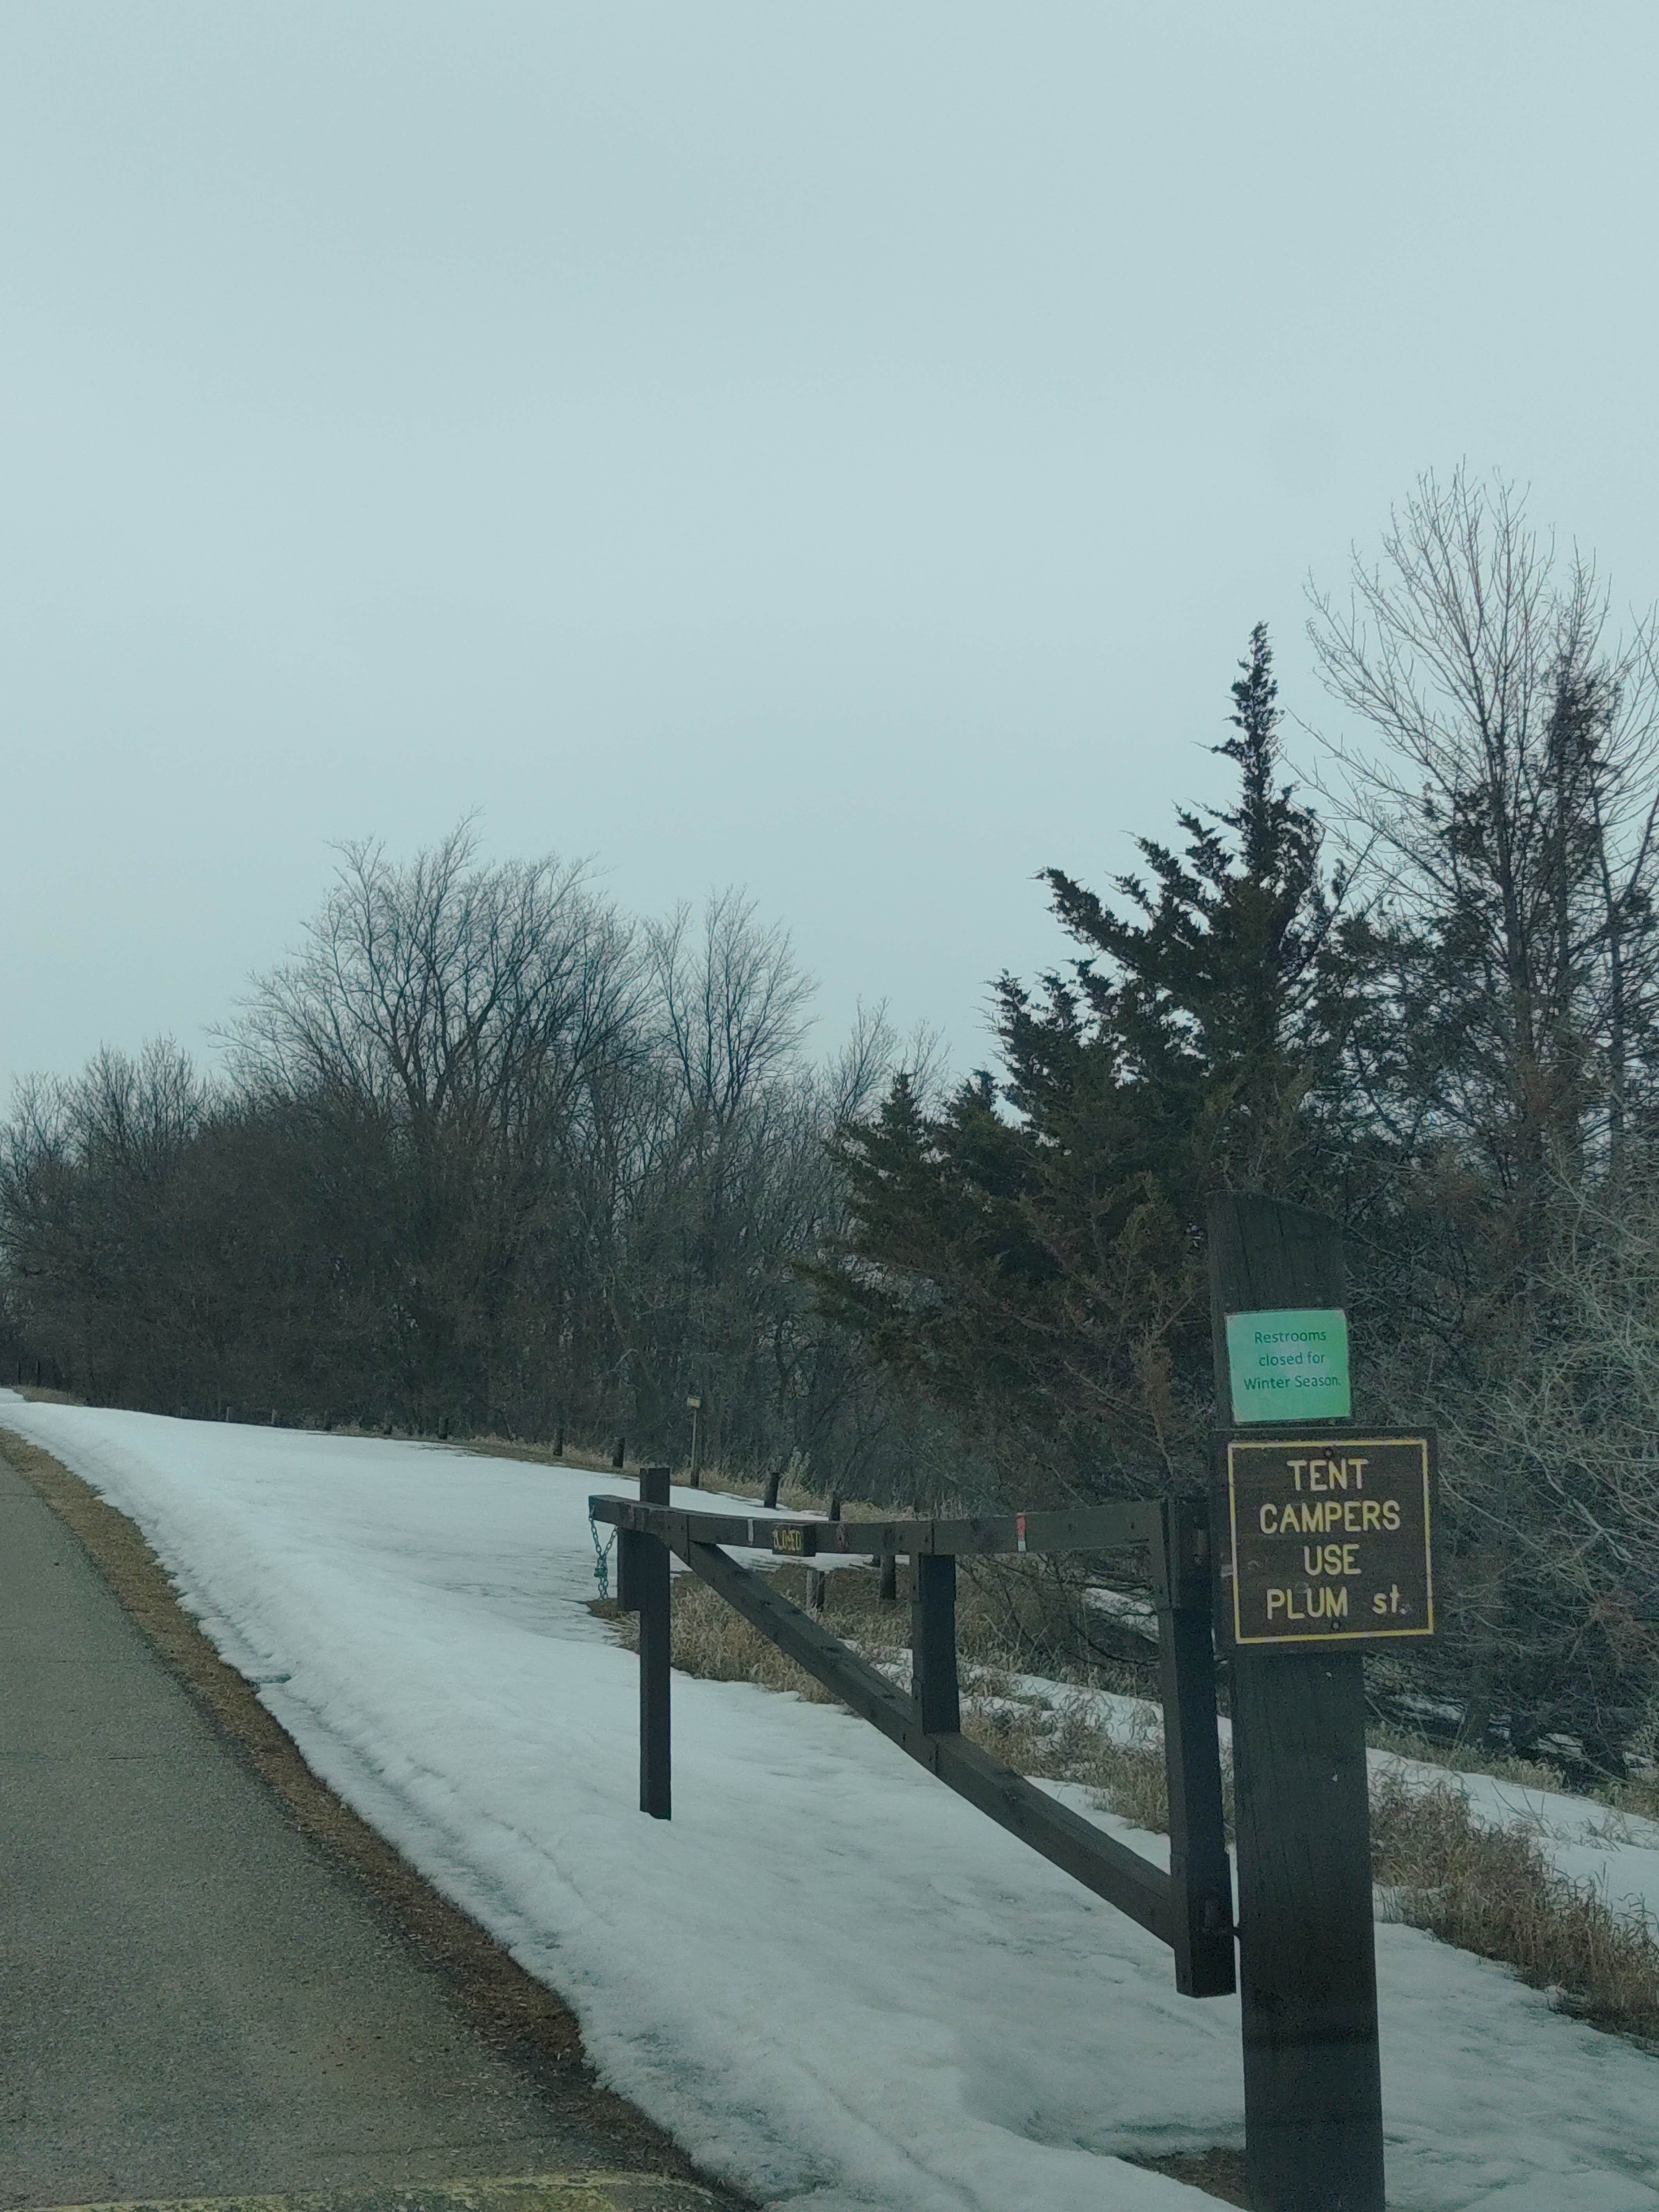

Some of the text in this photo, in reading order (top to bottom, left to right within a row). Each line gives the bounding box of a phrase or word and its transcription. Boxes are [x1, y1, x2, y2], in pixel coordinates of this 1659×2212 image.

[1254, 1331, 1326, 1343] Restrooms
[1259, 1351, 1325, 1366] closed for
[1243, 1375, 1341, 1390] Winter Season.
[1286, 1458, 1368, 1491] TENT
[1259, 1500, 1400, 1534] CAMPERS
[1304, 1544, 1361, 1576] USE
[1267, 1584, 1406, 1619] PLUM st.
